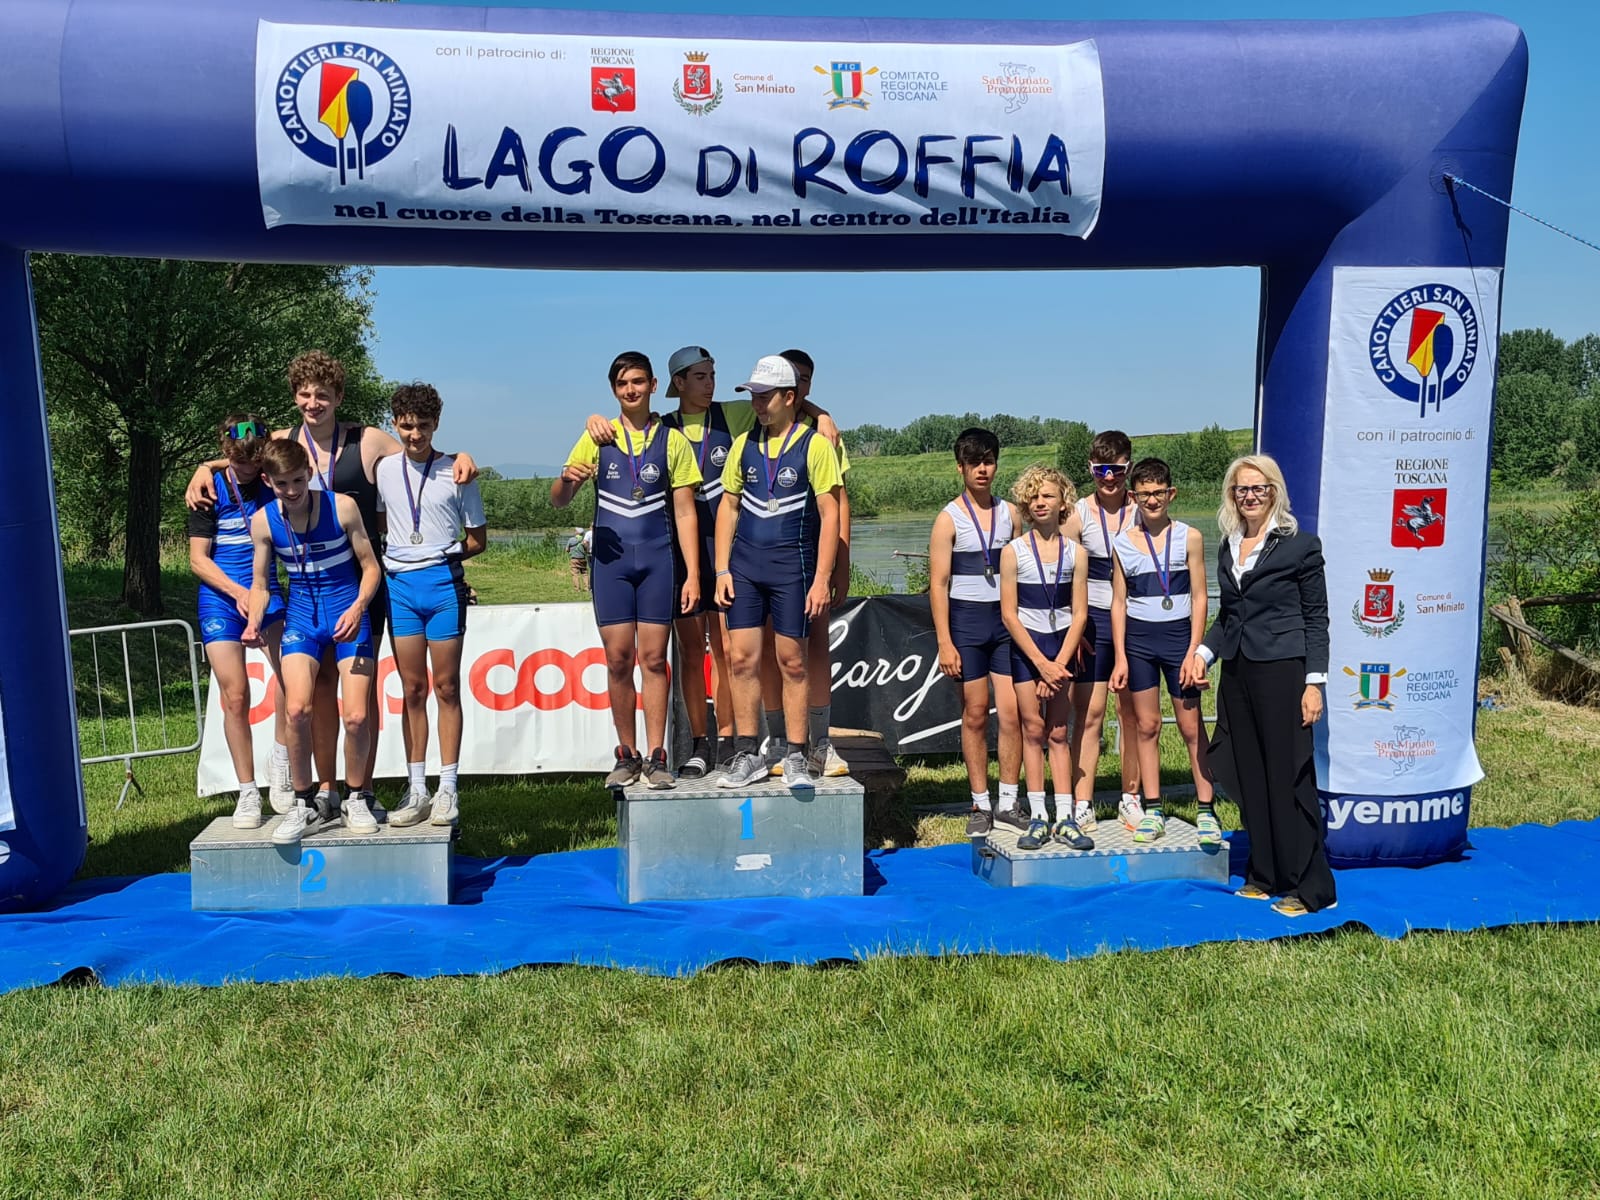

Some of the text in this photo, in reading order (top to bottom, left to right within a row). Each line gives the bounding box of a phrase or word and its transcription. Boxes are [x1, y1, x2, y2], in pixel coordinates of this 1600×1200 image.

[435, 46, 567, 60] con il patrocinio di:
[590, 47, 635, 56] REGIONE
[591, 56, 635, 65] TOSCANA
[733, 73, 774, 81] Comune di
[880, 71, 940, 81] COMITATO
[734, 82, 795, 94] San Miniato
[880, 81, 949, 91] REGIONALE
[278, 44, 409, 148] CANOTTIERI SAN MINIATO
[881, 91, 938, 101] TOSCANA
[442, 122, 1072, 199] LAGO DI ROFFIA
[333, 201, 1071, 228] nel cuore della Toscana, nel centro dell'Italia
[1371, 287, 1477, 383] CANOTTIERI SAN MINIATO
[1356, 427, 1476, 445] con il patrocinio di:
[1394, 458, 1449, 470] REGIONE
[1394, 472, 1448, 485] TOSCANA
[1416, 592, 1452, 602] Comune di
[1416, 601, 1465, 614] San Miniato
[1366, 664, 1385, 672] FIC
[1406, 669, 1455, 682] COMITATO
[1406, 678, 1460, 692] REGIONALE
[1406, 690, 1452, 703] TOSCANA
[738, 797, 756, 840] 1
[301, 849, 327, 892] 2
